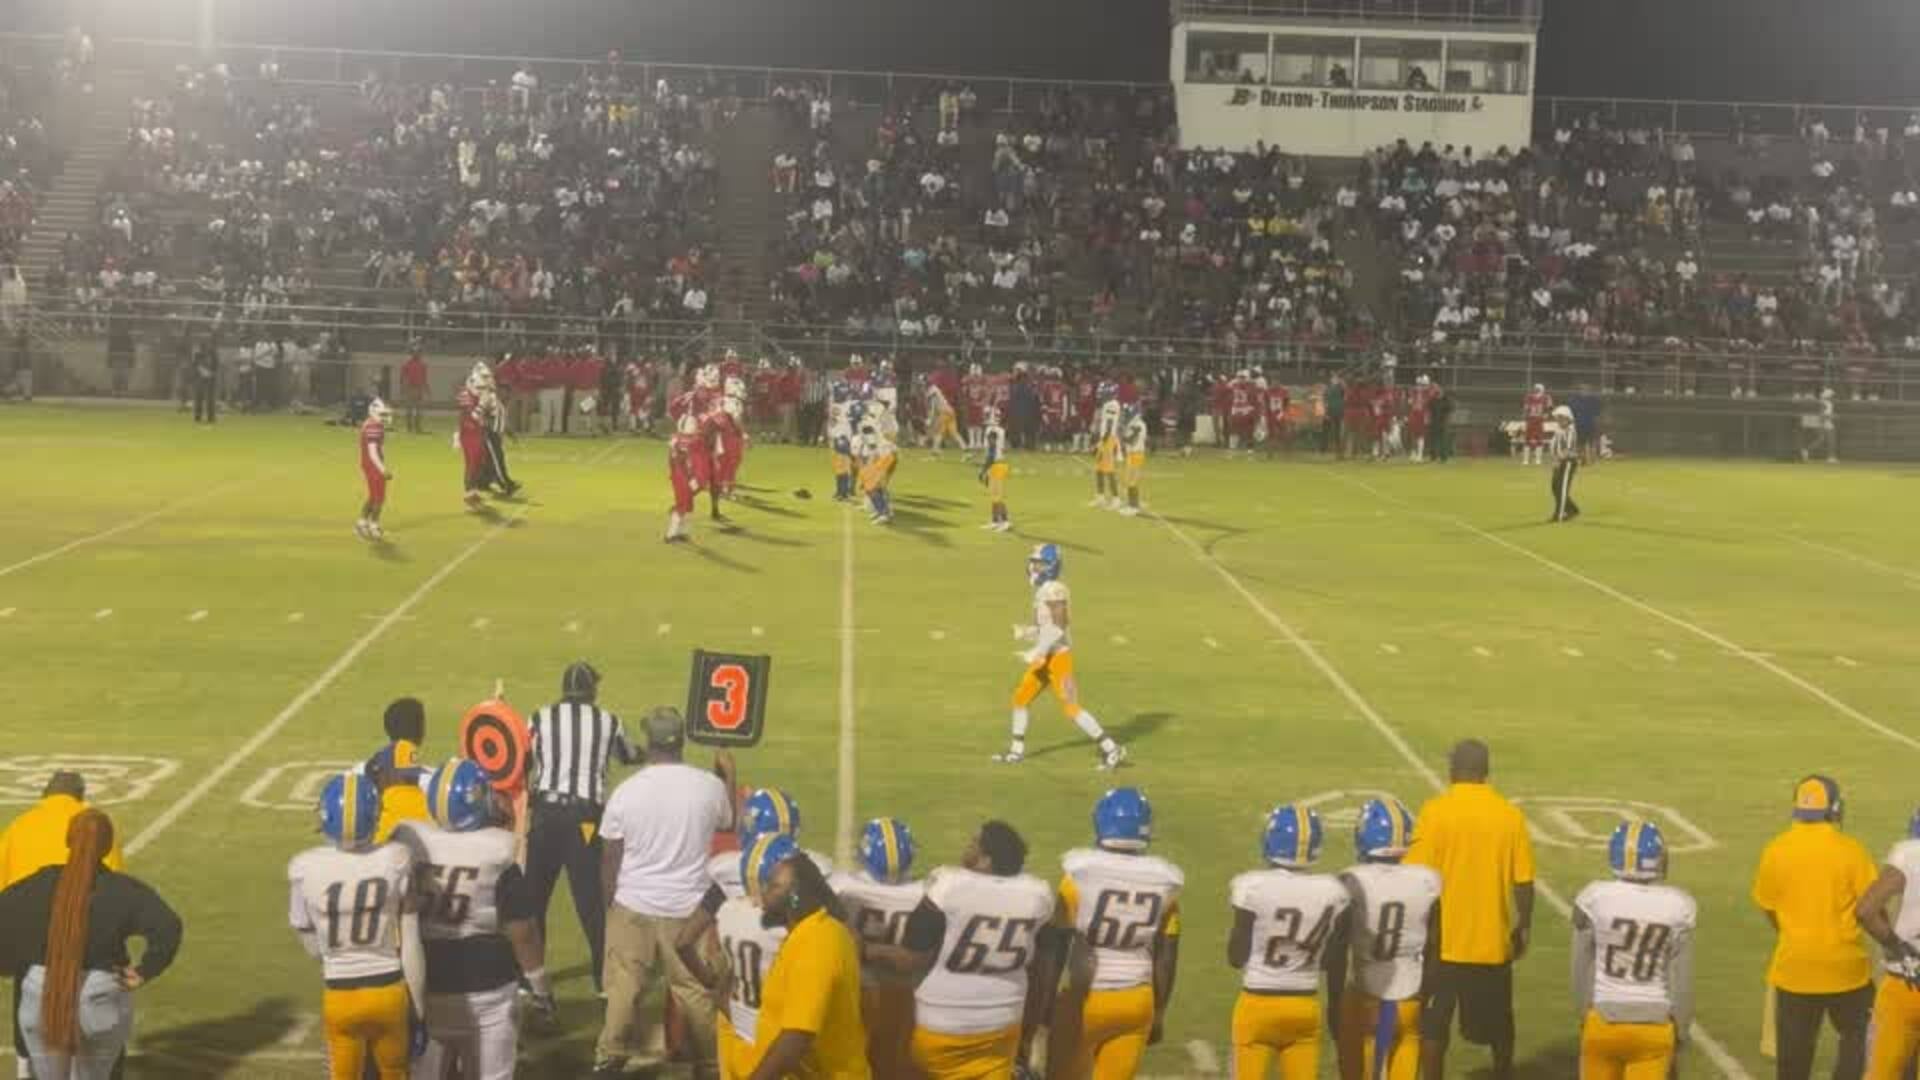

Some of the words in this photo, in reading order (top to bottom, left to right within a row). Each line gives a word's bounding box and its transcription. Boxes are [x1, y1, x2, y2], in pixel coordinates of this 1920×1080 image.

[1403, 94, 1467, 113] STADIUM
[707, 664, 749, 729] 3
[327, 877, 389, 949] 18
[1087, 888, 1162, 949] 62
[1264, 905, 1335, 967] 24
[1373, 902, 1406, 961] 8
[945, 914, 1038, 974] 65
[1604, 917, 1671, 982] 28
